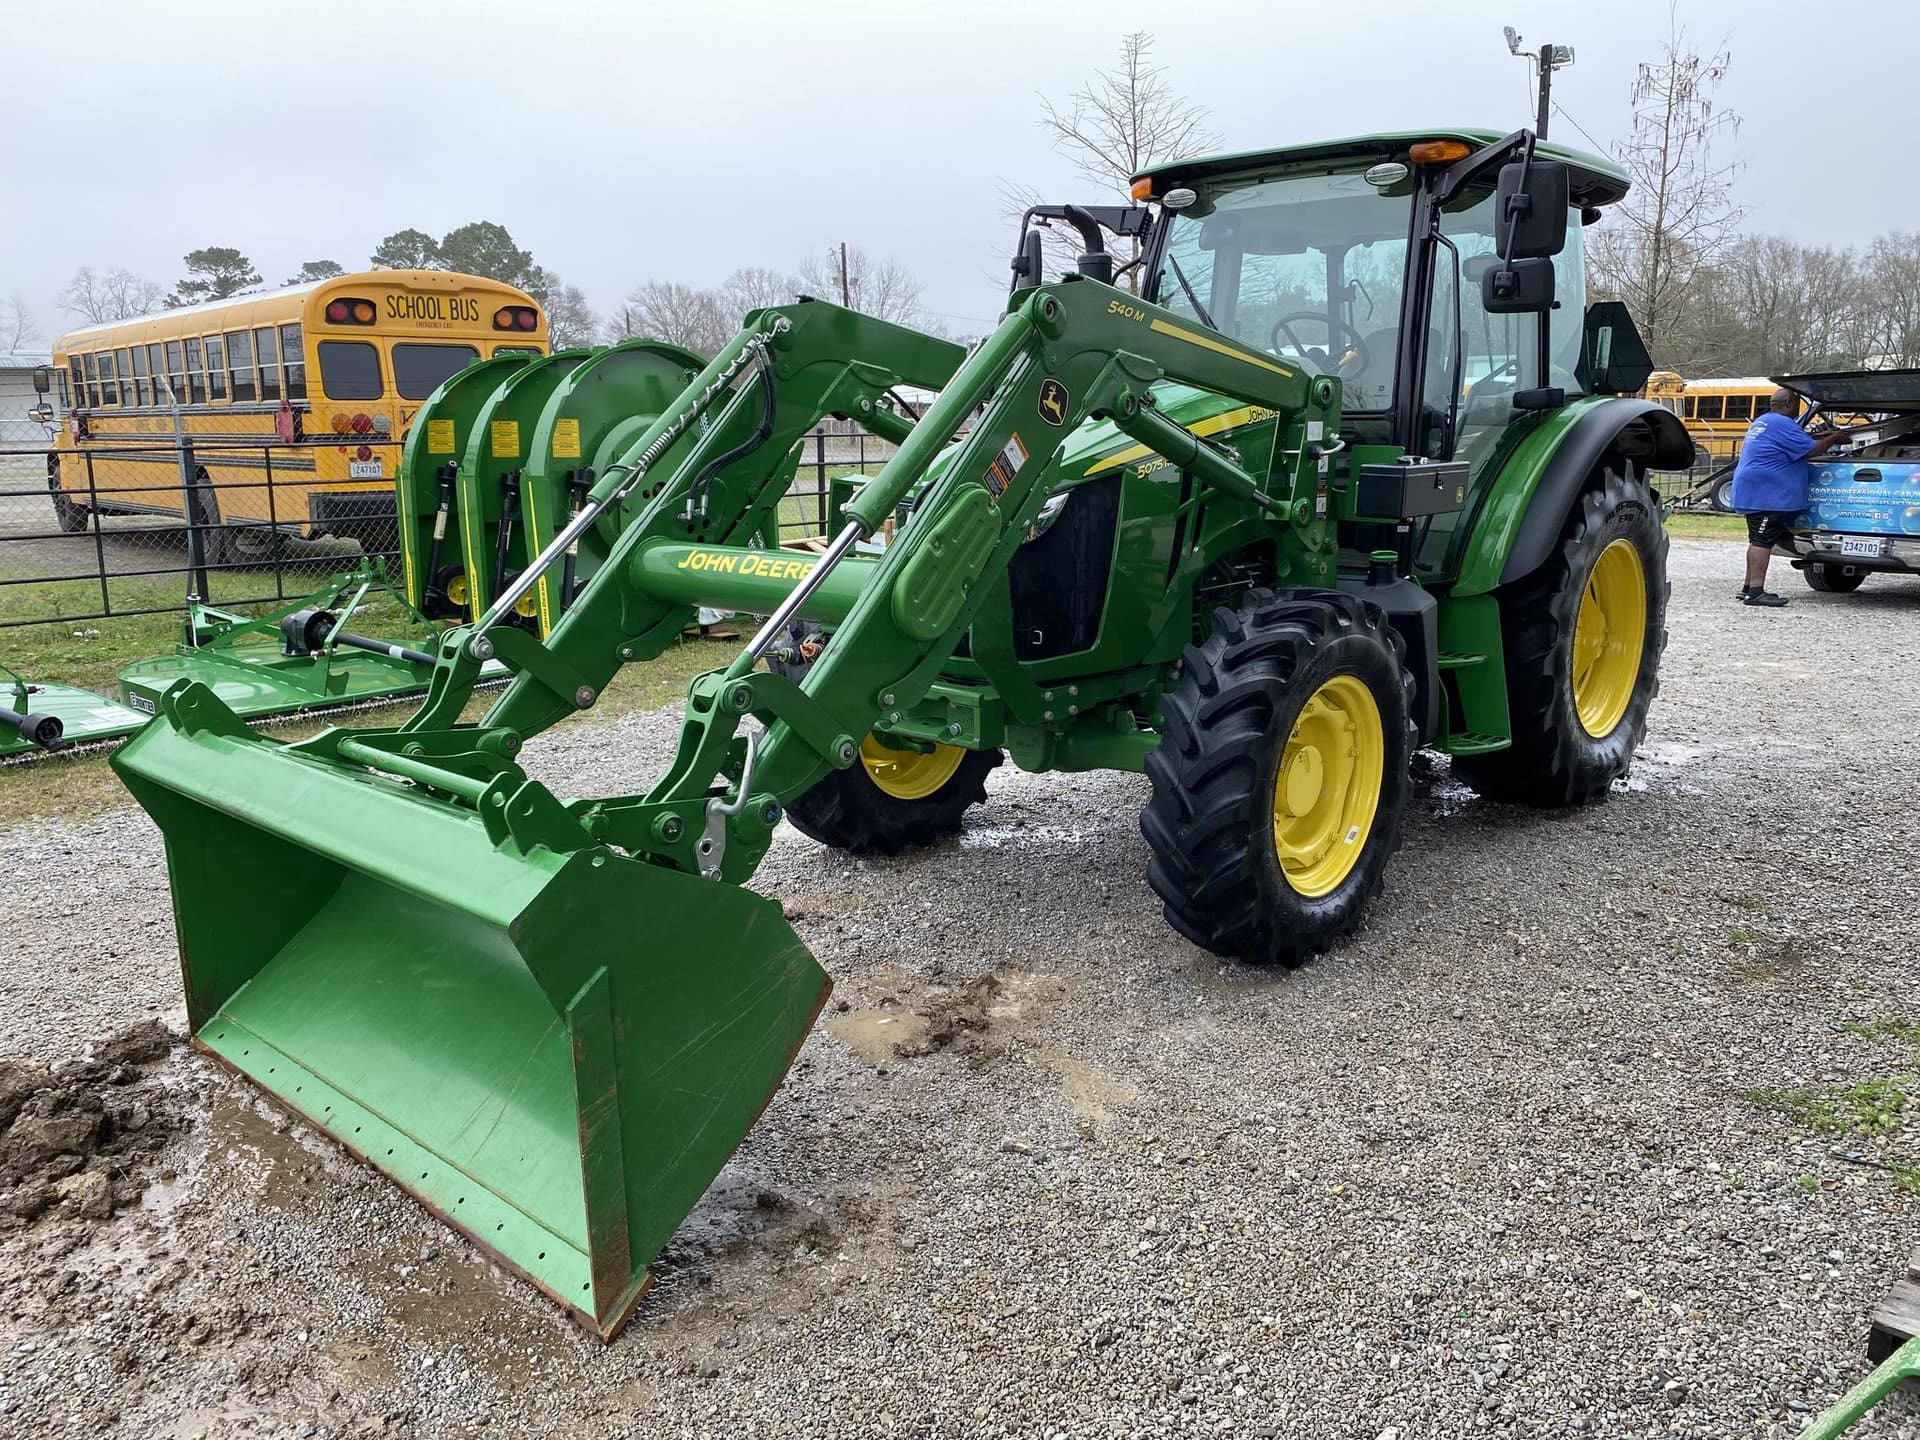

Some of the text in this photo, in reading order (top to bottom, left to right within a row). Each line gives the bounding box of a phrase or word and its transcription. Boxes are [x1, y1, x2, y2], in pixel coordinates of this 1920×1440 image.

[386, 294, 480, 322] SCHOOL BUS
[1843, 542, 1879, 553] Z342103
[678, 550, 817, 580] JOHN DEERE
